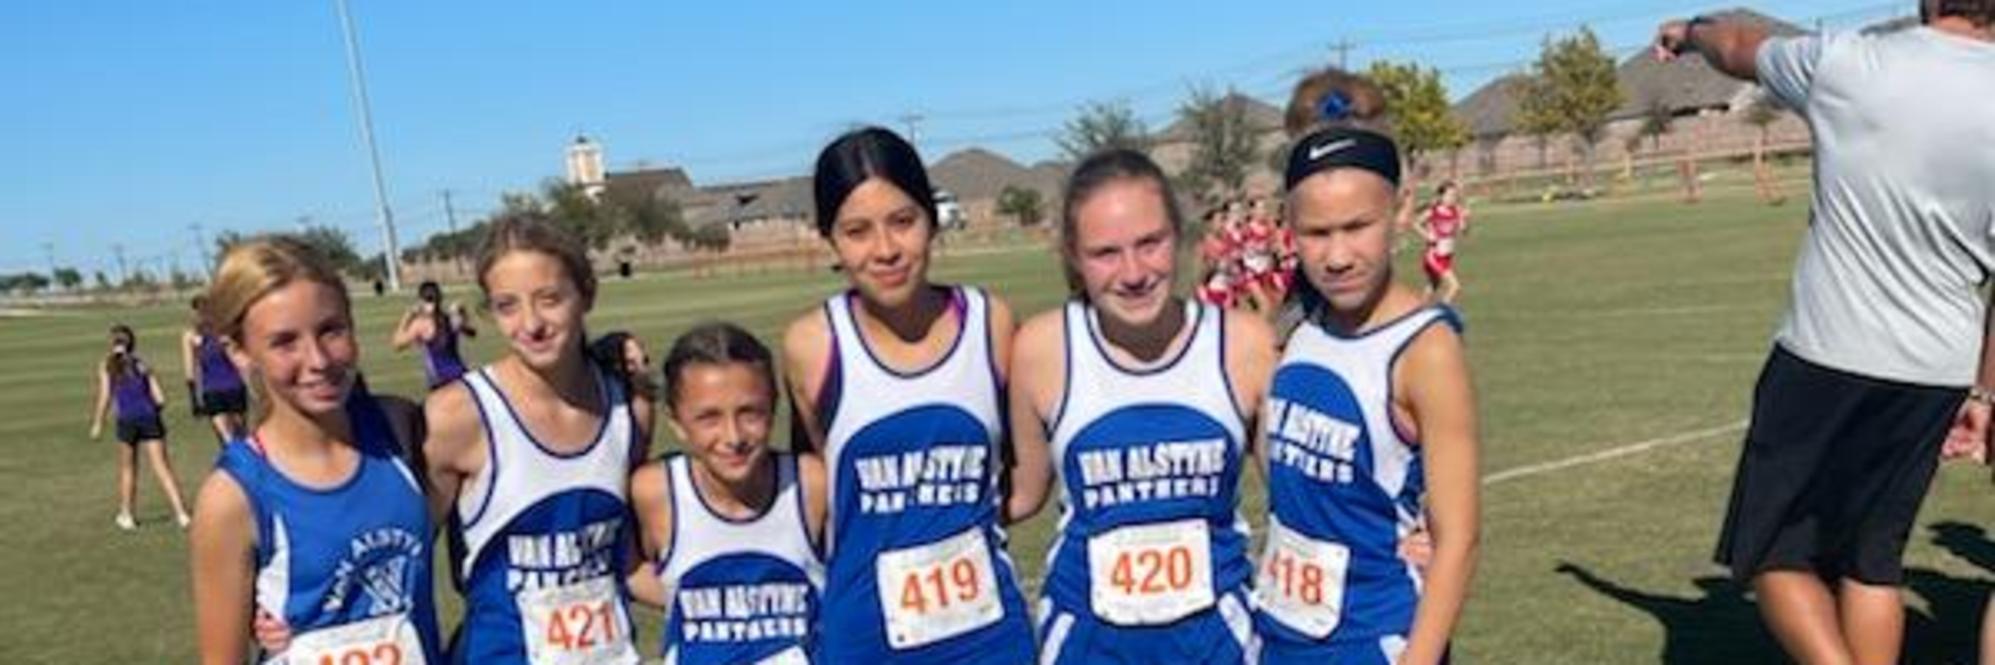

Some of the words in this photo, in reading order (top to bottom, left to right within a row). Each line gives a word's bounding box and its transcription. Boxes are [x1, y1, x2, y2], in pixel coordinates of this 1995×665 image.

[855, 454, 898, 489] VAN
[1077, 448, 1122, 486] VAN
[1127, 438, 1226, 480] ALSTYNE
[860, 482, 979, 513] PANHES
[507, 534, 552, 568] VAN
[1110, 546, 1192, 595] 420
[679, 587, 721, 620] VAN
[725, 582, 809, 619] ALSTYNE
[901, 557, 979, 616] 419
[548, 602, 615, 650] 421
